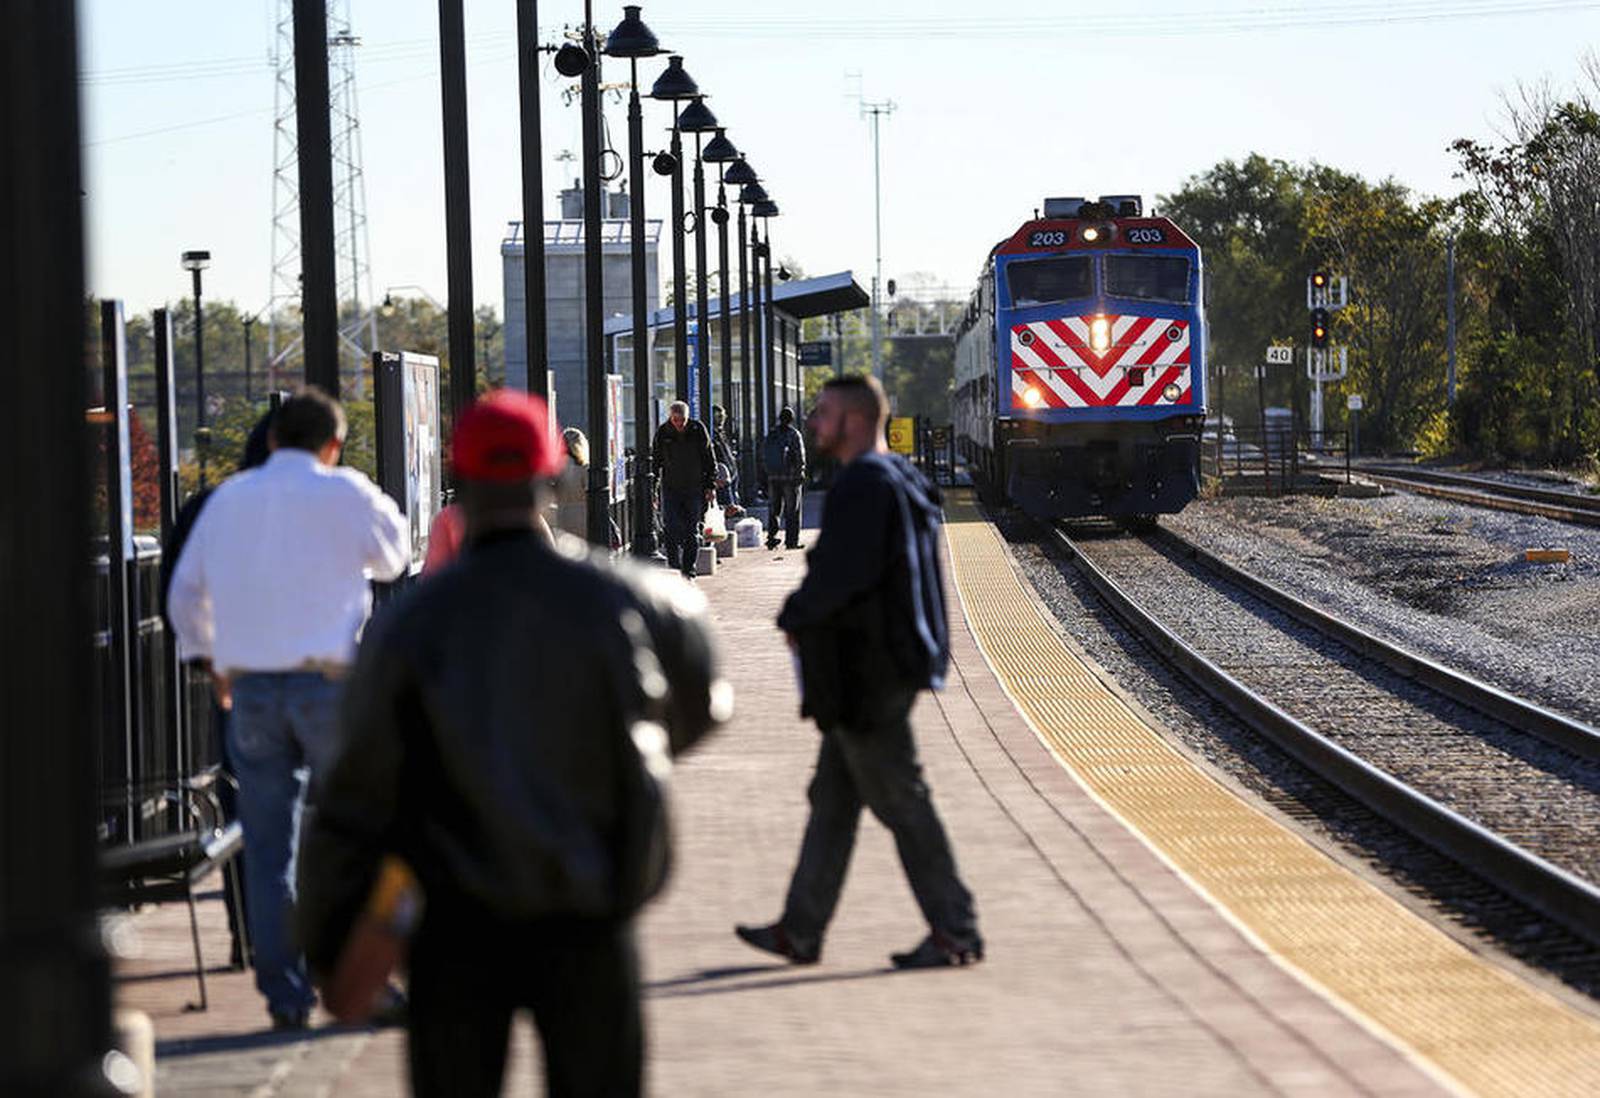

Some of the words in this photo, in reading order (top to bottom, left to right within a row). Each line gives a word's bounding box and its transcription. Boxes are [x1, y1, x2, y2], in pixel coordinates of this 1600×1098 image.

[1032, 231, 1065, 246] 203
[1129, 229, 1162, 242] 203
[1270, 349, 1289, 361] 40
